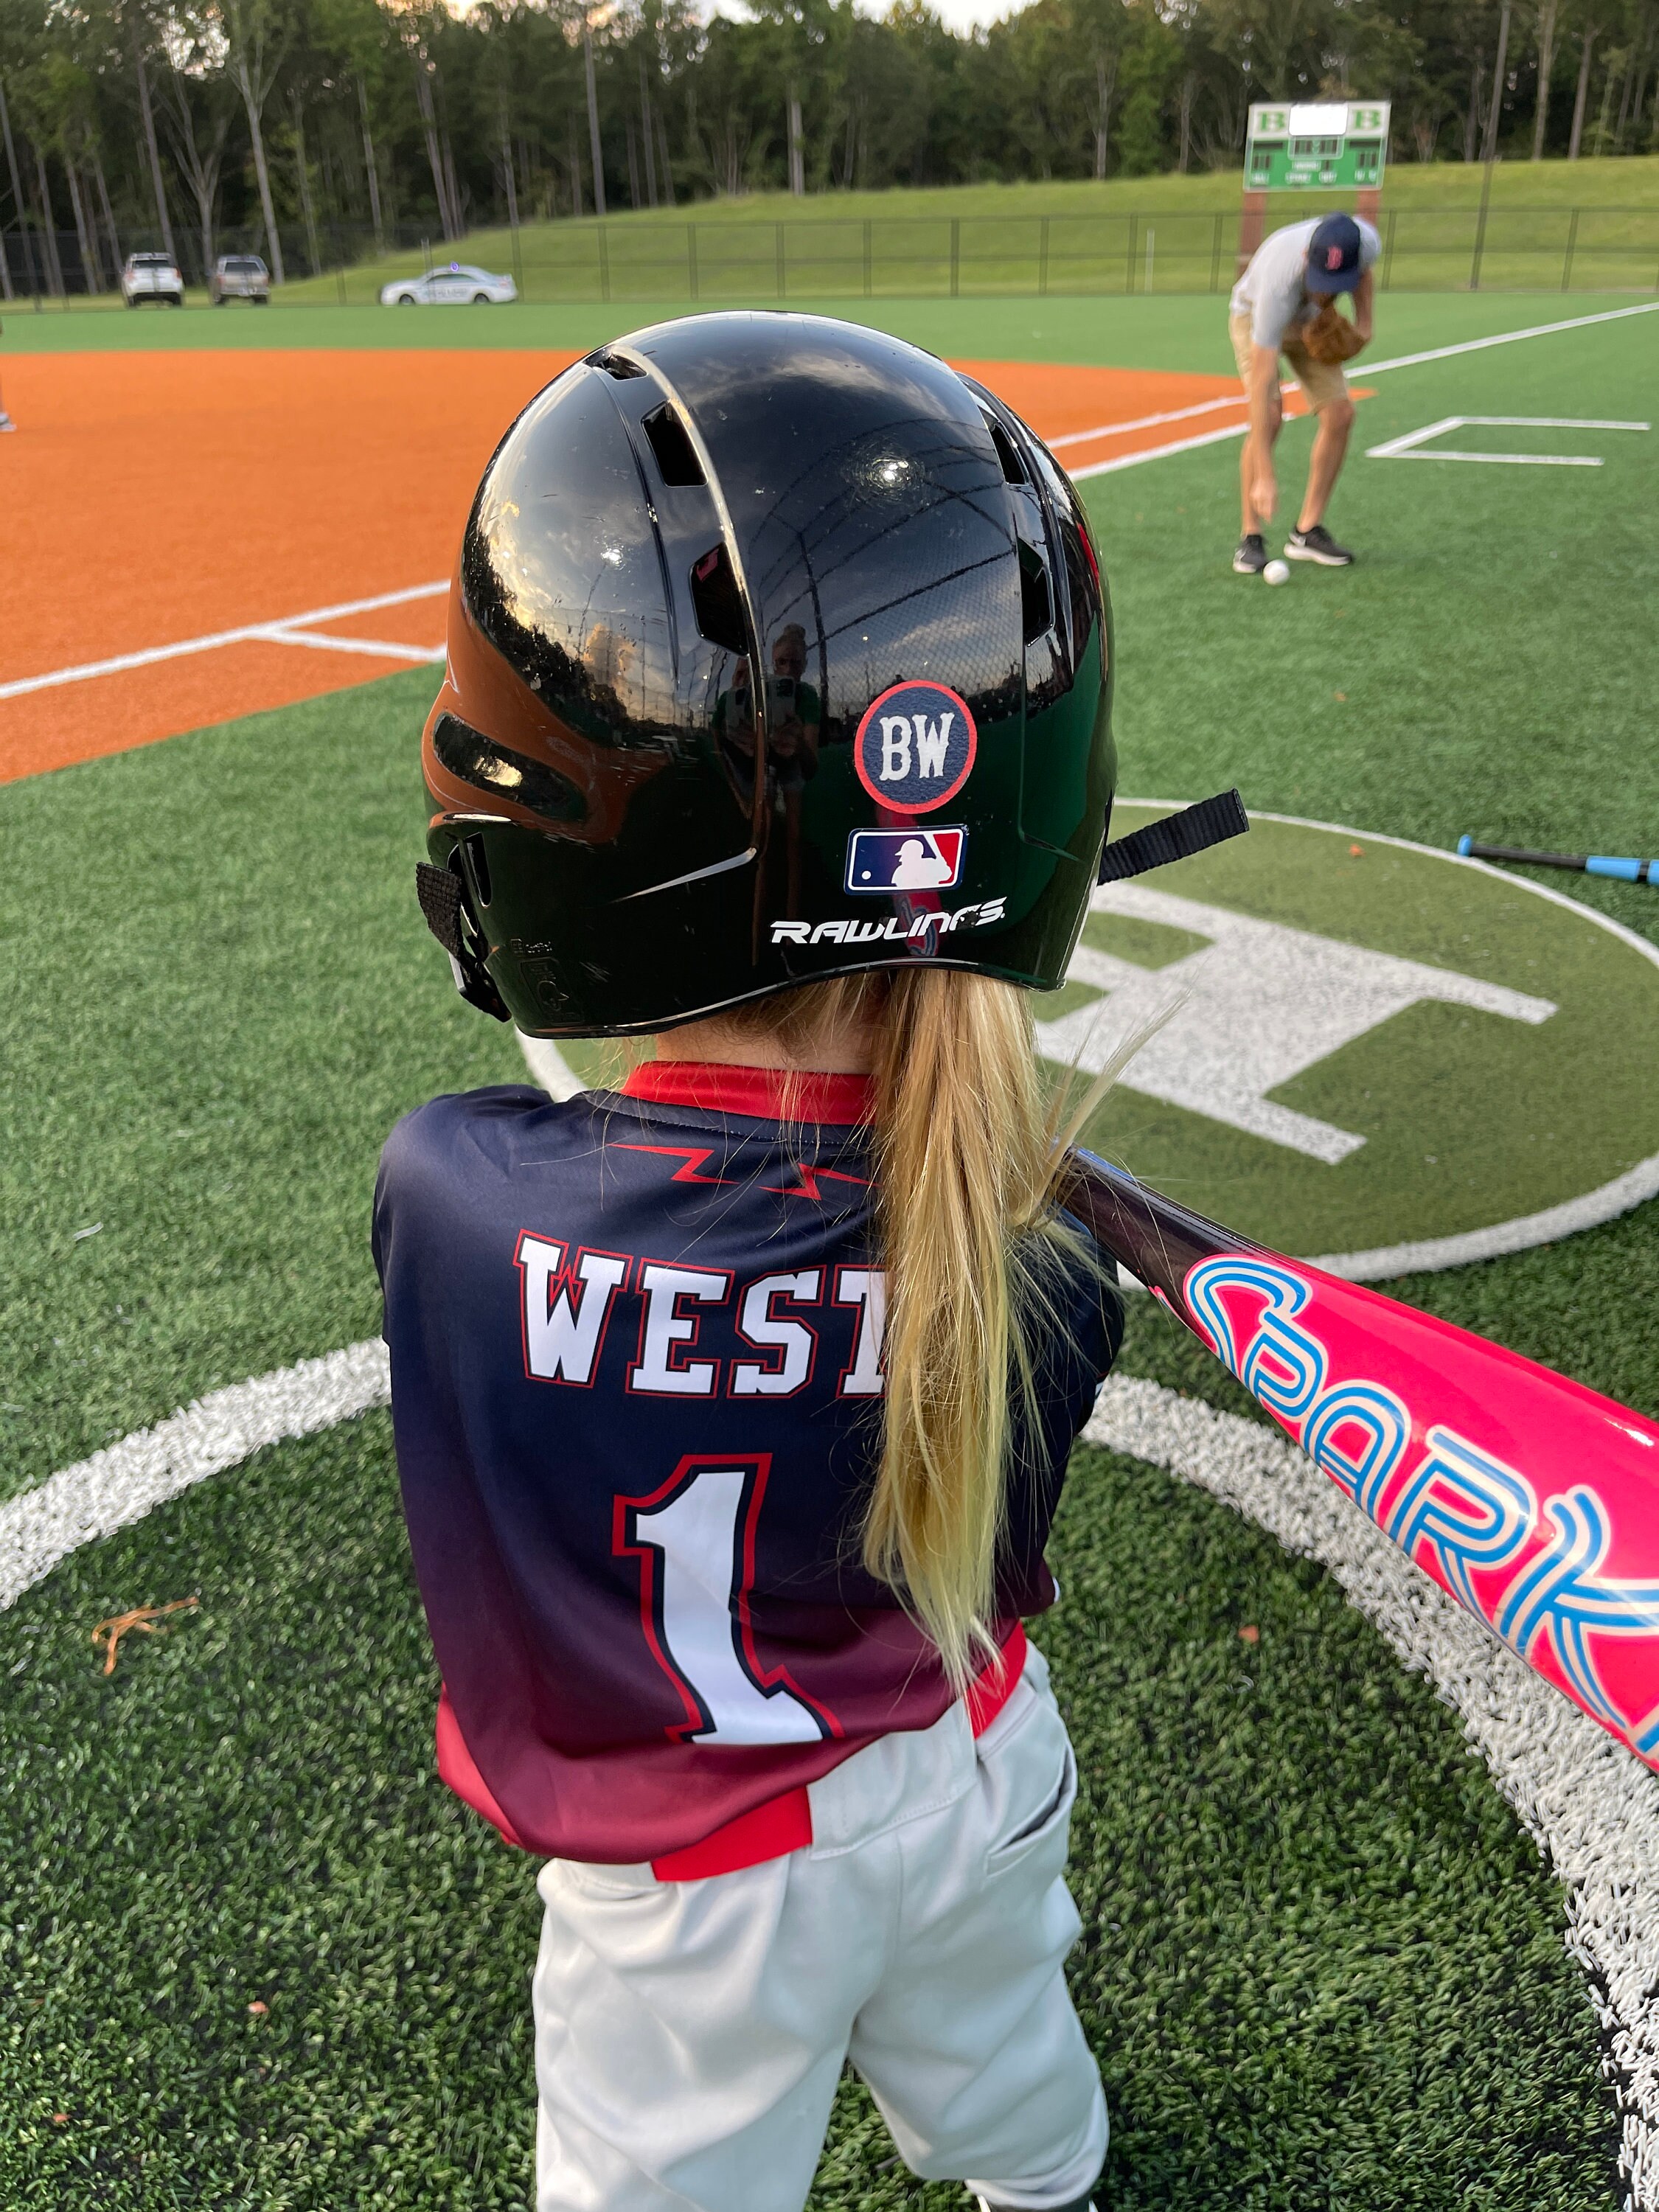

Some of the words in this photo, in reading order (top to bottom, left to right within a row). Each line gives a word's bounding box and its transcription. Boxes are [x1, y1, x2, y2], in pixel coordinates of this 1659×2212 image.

[879, 712, 956, 781] BW
[514, 1229, 886, 1399] WEST
[616, 1455, 844, 1745] 1
